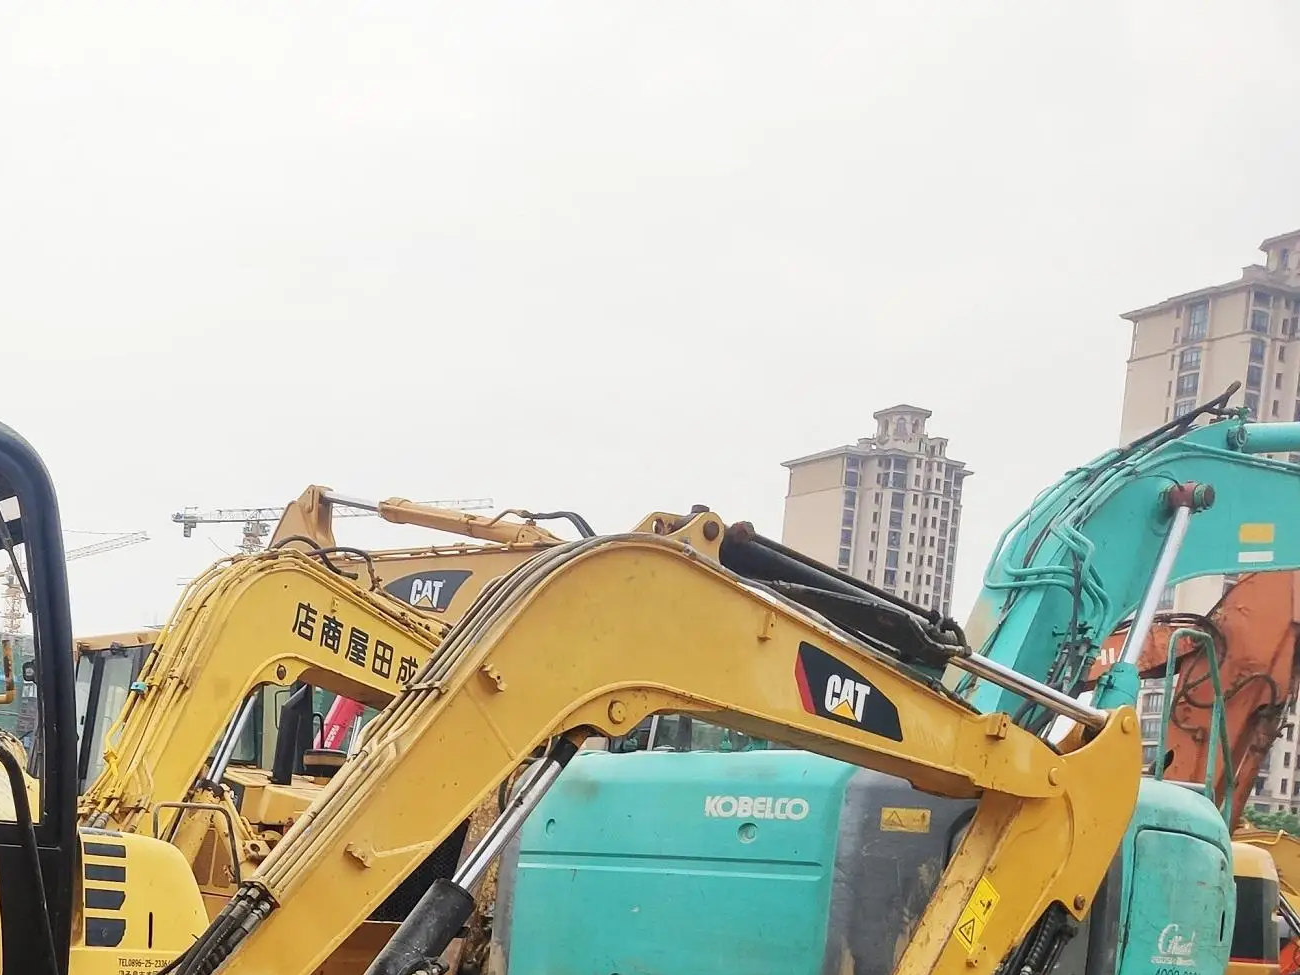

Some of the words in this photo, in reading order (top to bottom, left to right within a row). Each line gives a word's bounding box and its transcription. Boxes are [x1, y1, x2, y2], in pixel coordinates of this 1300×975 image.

[410, 578, 443, 608] CAT
[824, 674, 871, 723] CAT
[704, 795, 809, 820] KOBELCO
